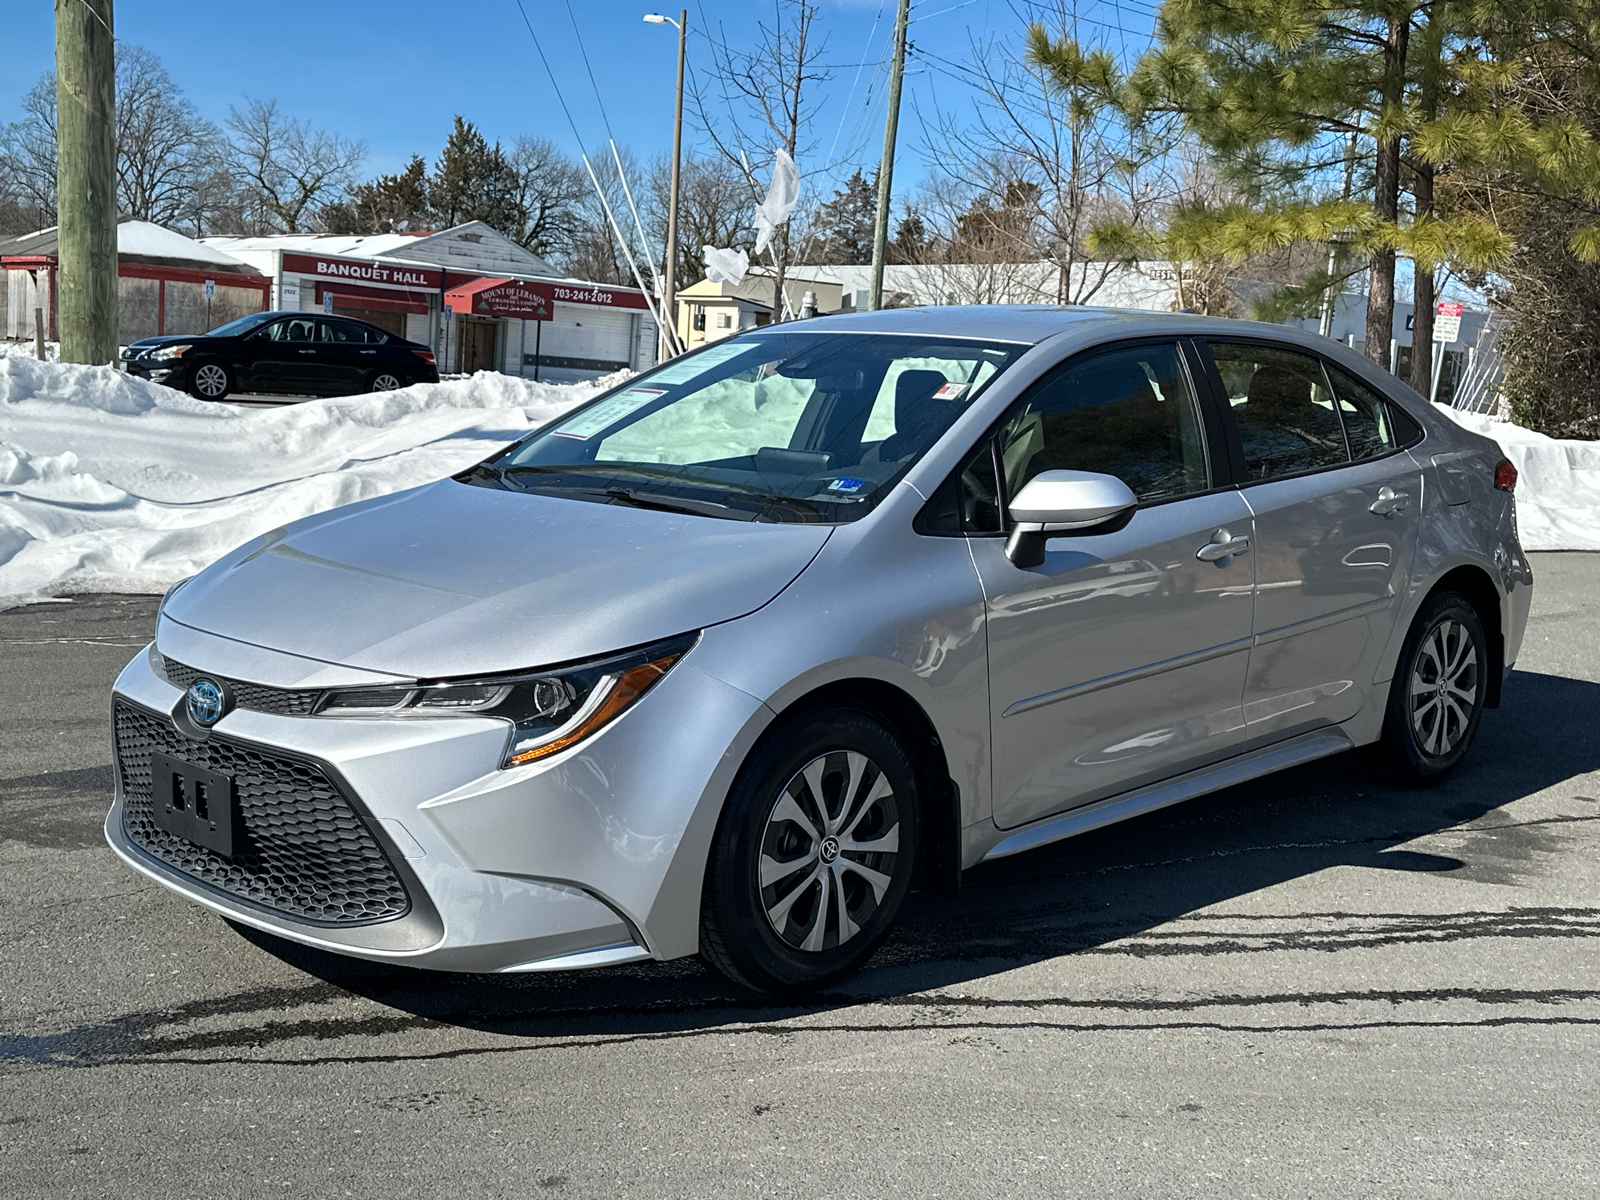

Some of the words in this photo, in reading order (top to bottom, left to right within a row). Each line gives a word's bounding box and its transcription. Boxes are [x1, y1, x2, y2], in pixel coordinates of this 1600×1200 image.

[317, 262, 389, 280] BANQUET
[393, 271, 428, 284] HALL
[481, 288, 505, 299] MOUNT
[516, 289, 546, 305] LEBANON
[554, 288, 612, 303] 703-241-2012
